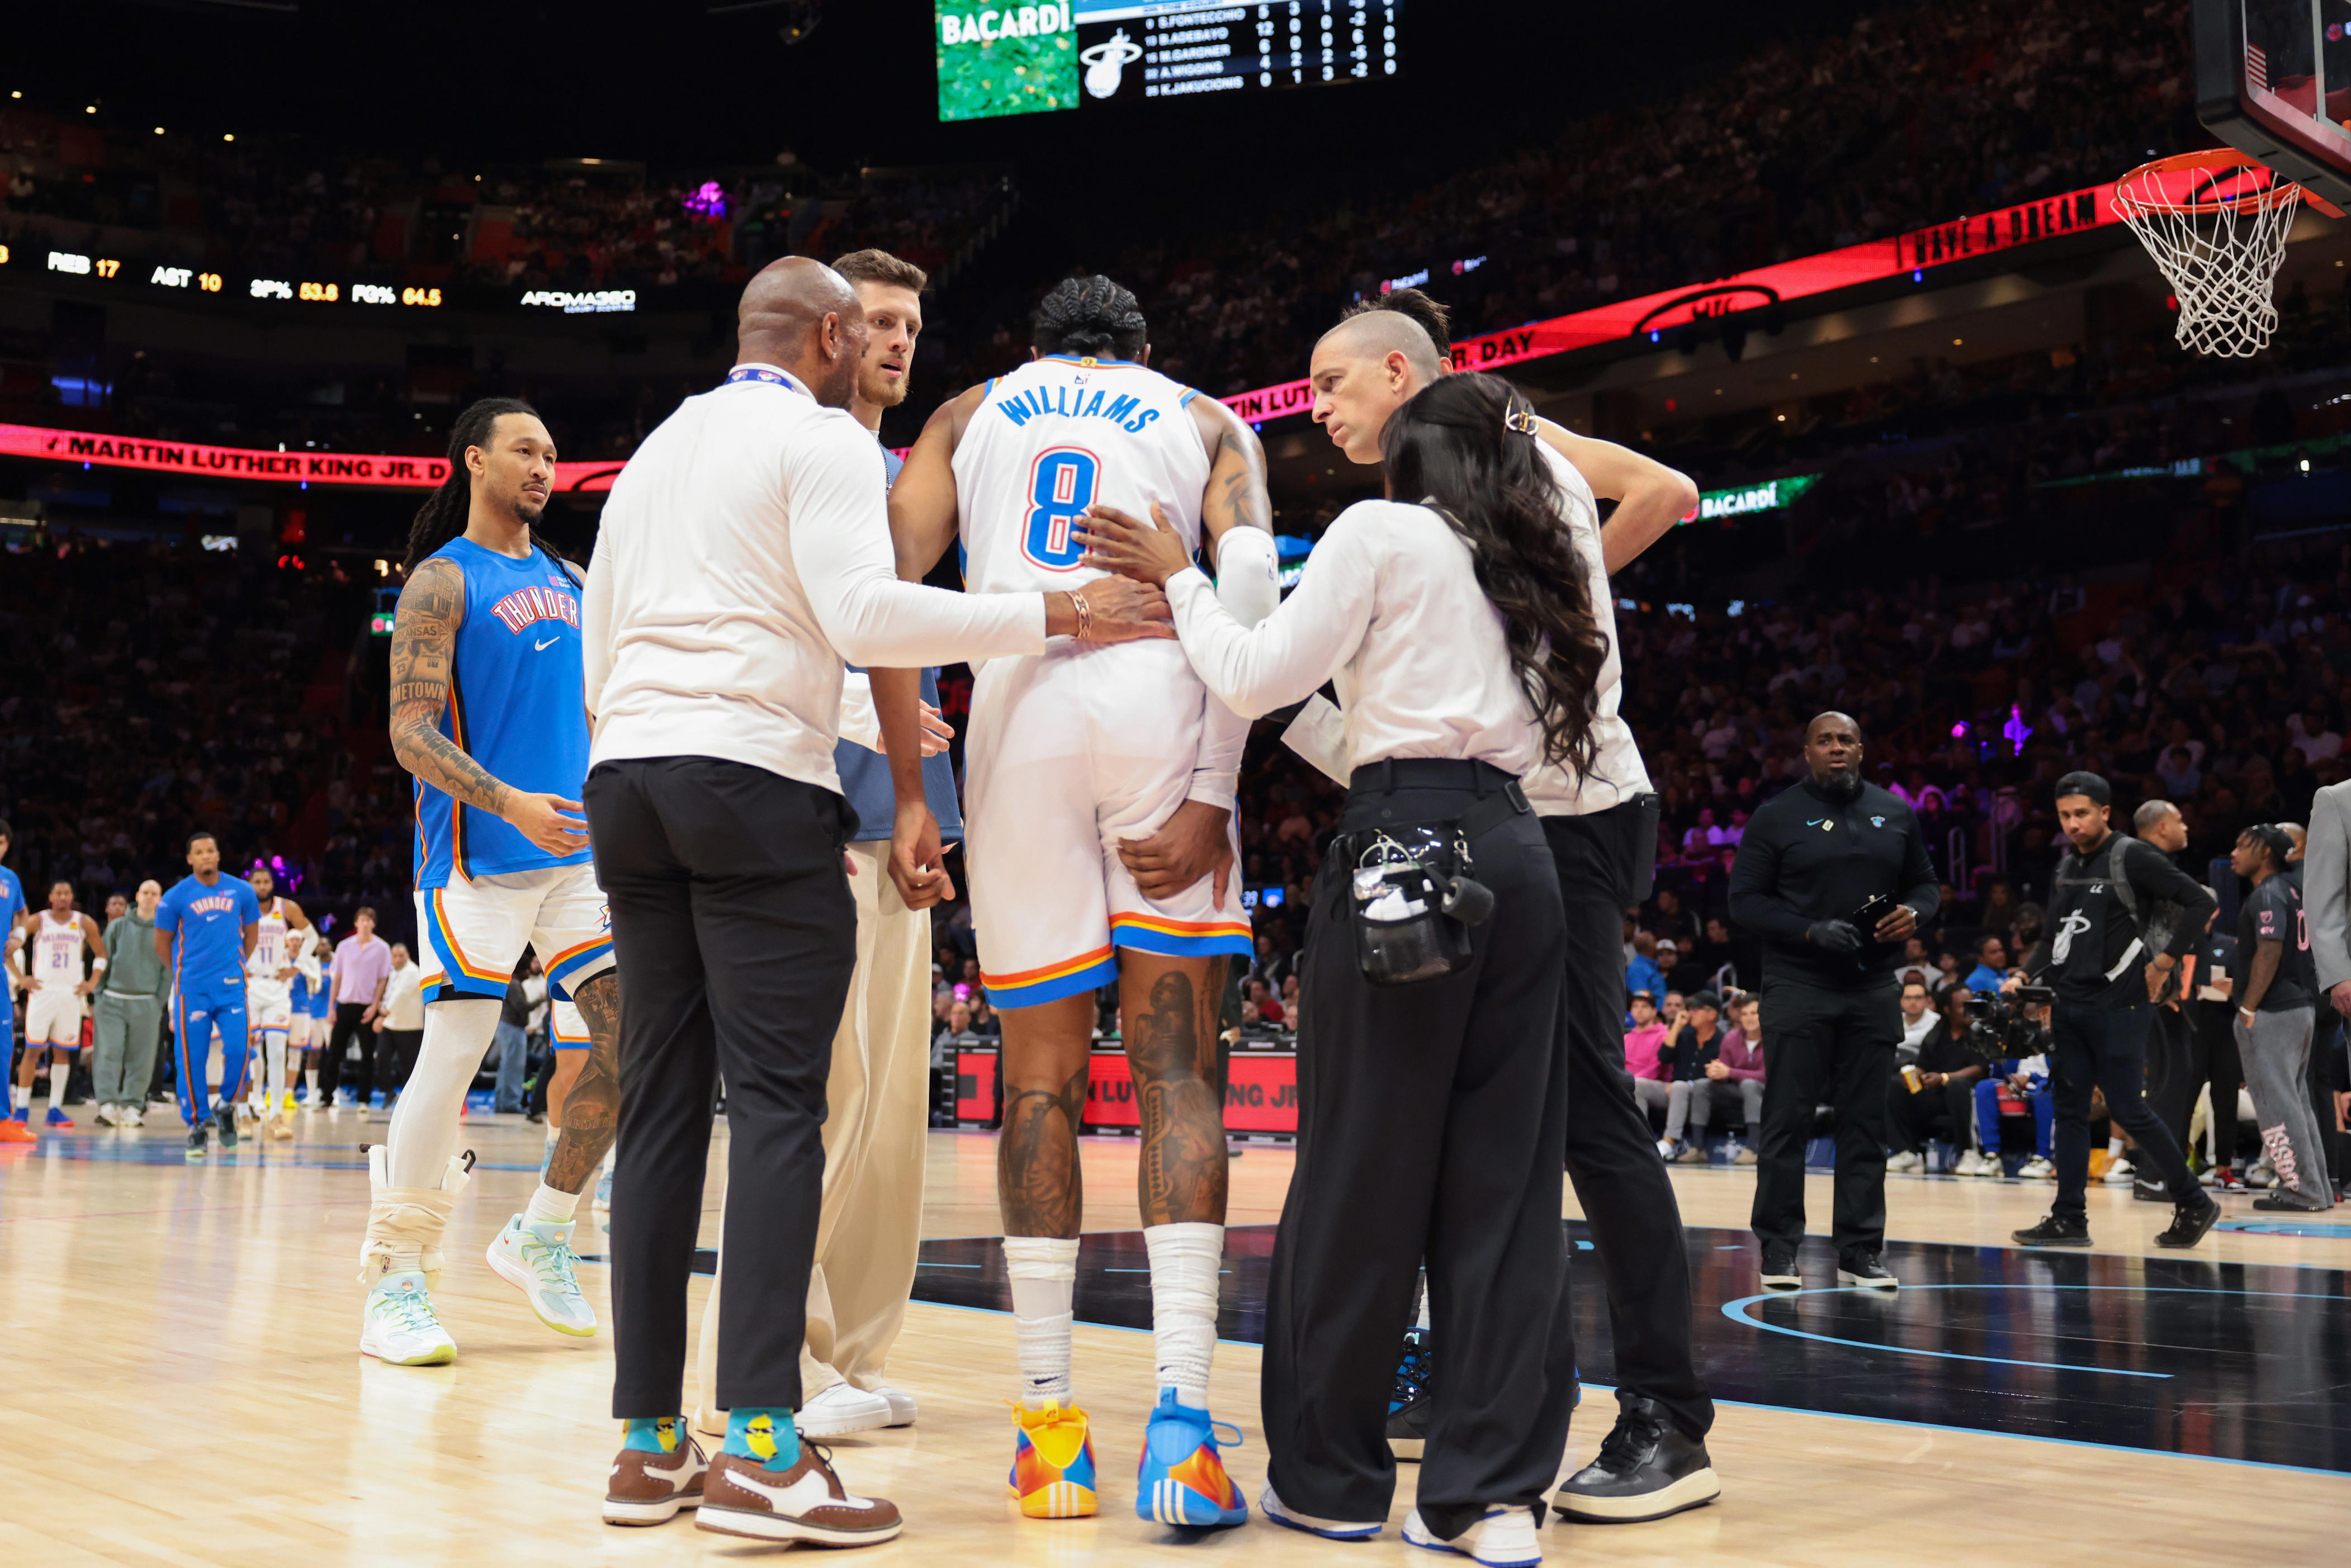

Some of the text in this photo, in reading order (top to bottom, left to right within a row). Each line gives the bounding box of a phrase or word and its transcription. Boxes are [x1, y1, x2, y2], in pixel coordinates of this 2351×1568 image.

[1255, 21, 1274, 36] 12
[1289, 18, 1301, 33] 0
[1321, 15, 1332, 30] 0
[1384, 7, 1394, 23] 1
[1258, 4, 1269, 20] 5
[1289, 1, 1300, 16] 3
[1259, 39, 1270, 54] 6
[1290, 35, 1302, 50] 0
[1321, 32, 1333, 47] 0
[1383, 25, 1396, 41] 0
[1260, 55, 1271, 69] 4
[1290, 51, 1302, 67] 2
[1322, 48, 1333, 63] 2
[1384, 41, 1396, 57] 0
[1260, 72, 1272, 87] 0
[1292, 69, 1302, 84] 1
[1322, 65, 1334, 81] 3
[1384, 59, 1397, 74] 0
[49, 252, 91, 274] REB
[96, 259, 120, 278] 17
[151, 266, 192, 287] AST
[198, 273, 222, 292] 10
[352, 284, 396, 305] FG%
[403, 287, 442, 307] 64.5
[521, 290, 636, 307] AROMA360
[1269, 385, 1311, 411] LUT
[1453, 349, 1473, 369] R.
[1482, 331, 1534, 361] DAY
[997, 386, 1160, 433] WILLIAMS
[70, 437, 183, 465] MARTIN
[192, 452, 301, 475] LUTHER
[309, 458, 372, 478] KING
[380, 460, 420, 479] JR.
[1020, 446, 1101, 573] 8
[490, 586, 579, 635] THUNDER
[391, 681, 446, 705] METOWN
[190, 896, 234, 915] THUNDER
[52, 952, 69, 968] 21
[261, 947, 273, 963] 11
[1227, 1083, 1264, 1107] NG
